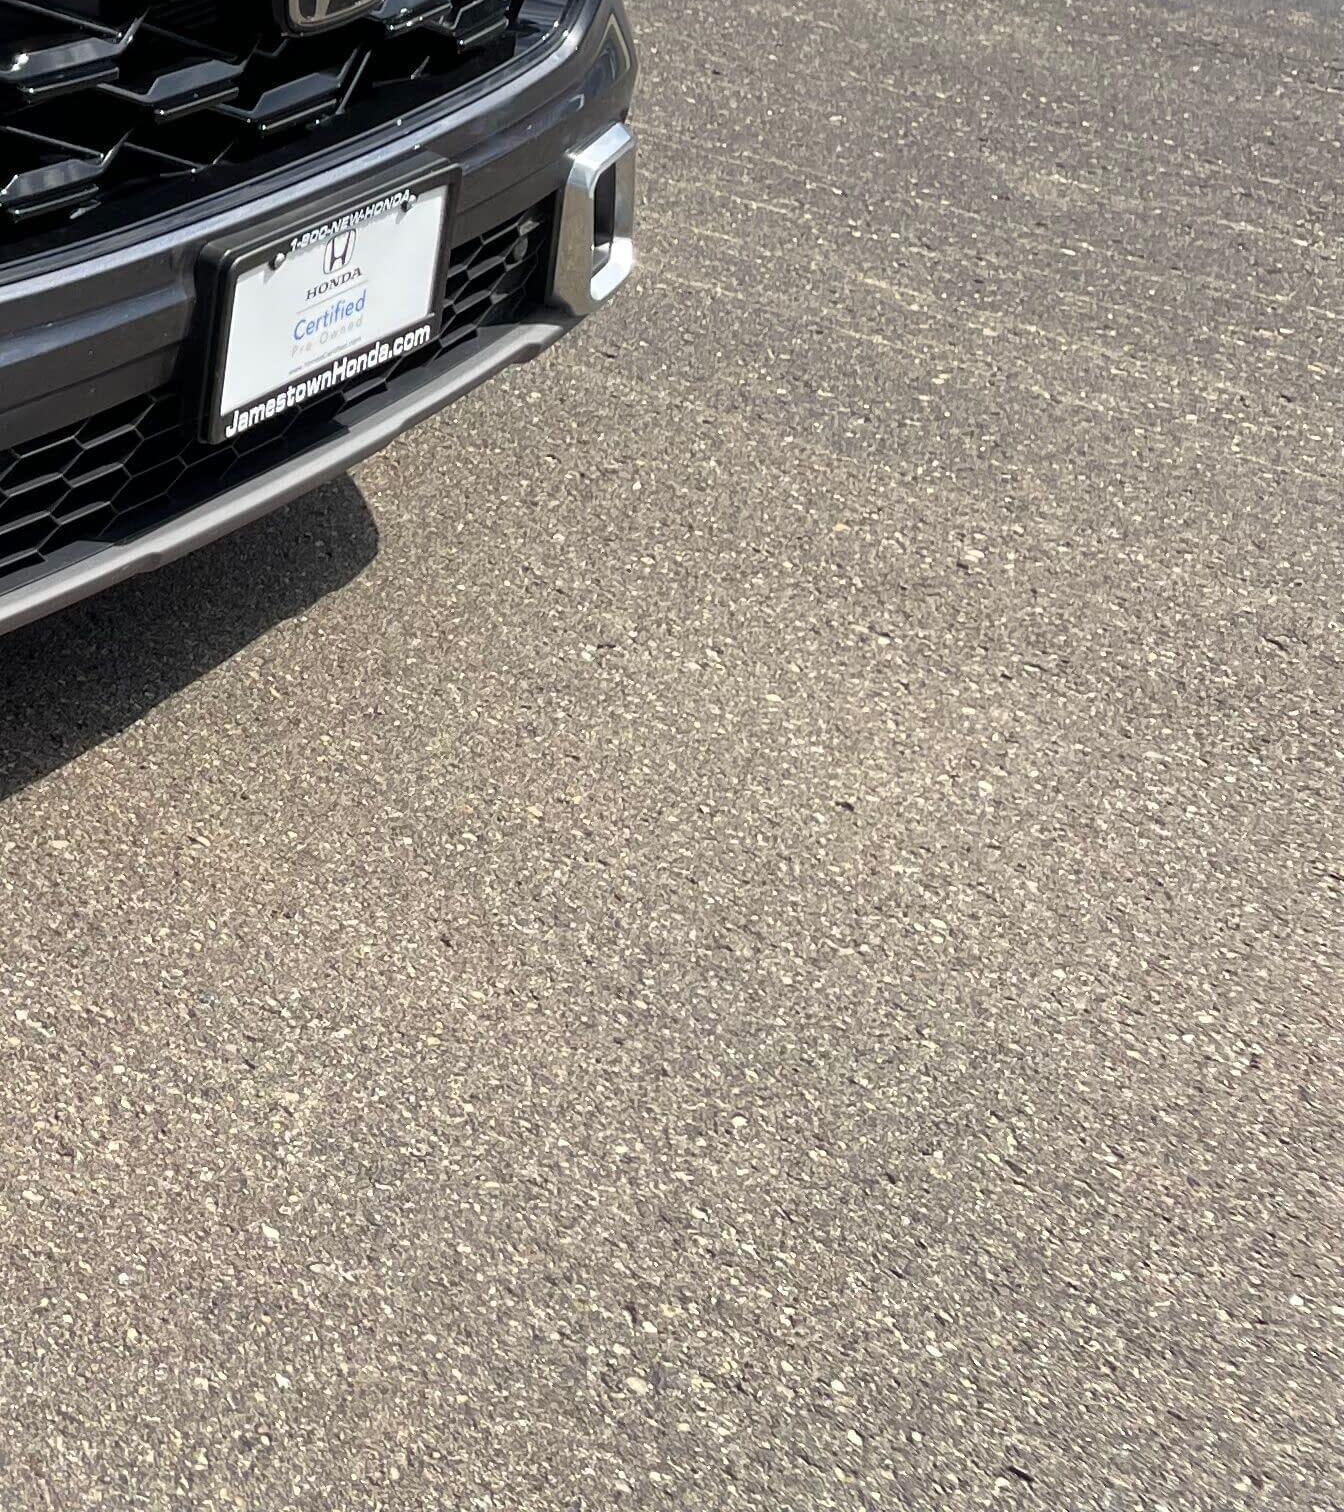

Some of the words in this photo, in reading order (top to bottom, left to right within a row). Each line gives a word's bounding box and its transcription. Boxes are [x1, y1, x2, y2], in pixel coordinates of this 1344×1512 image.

[305, 267, 363, 301] HONDA
[293, 289, 367, 341] Certified
[319, 314, 363, 345] Owned
[224, 324, 432, 439] JamestownHonda.com
